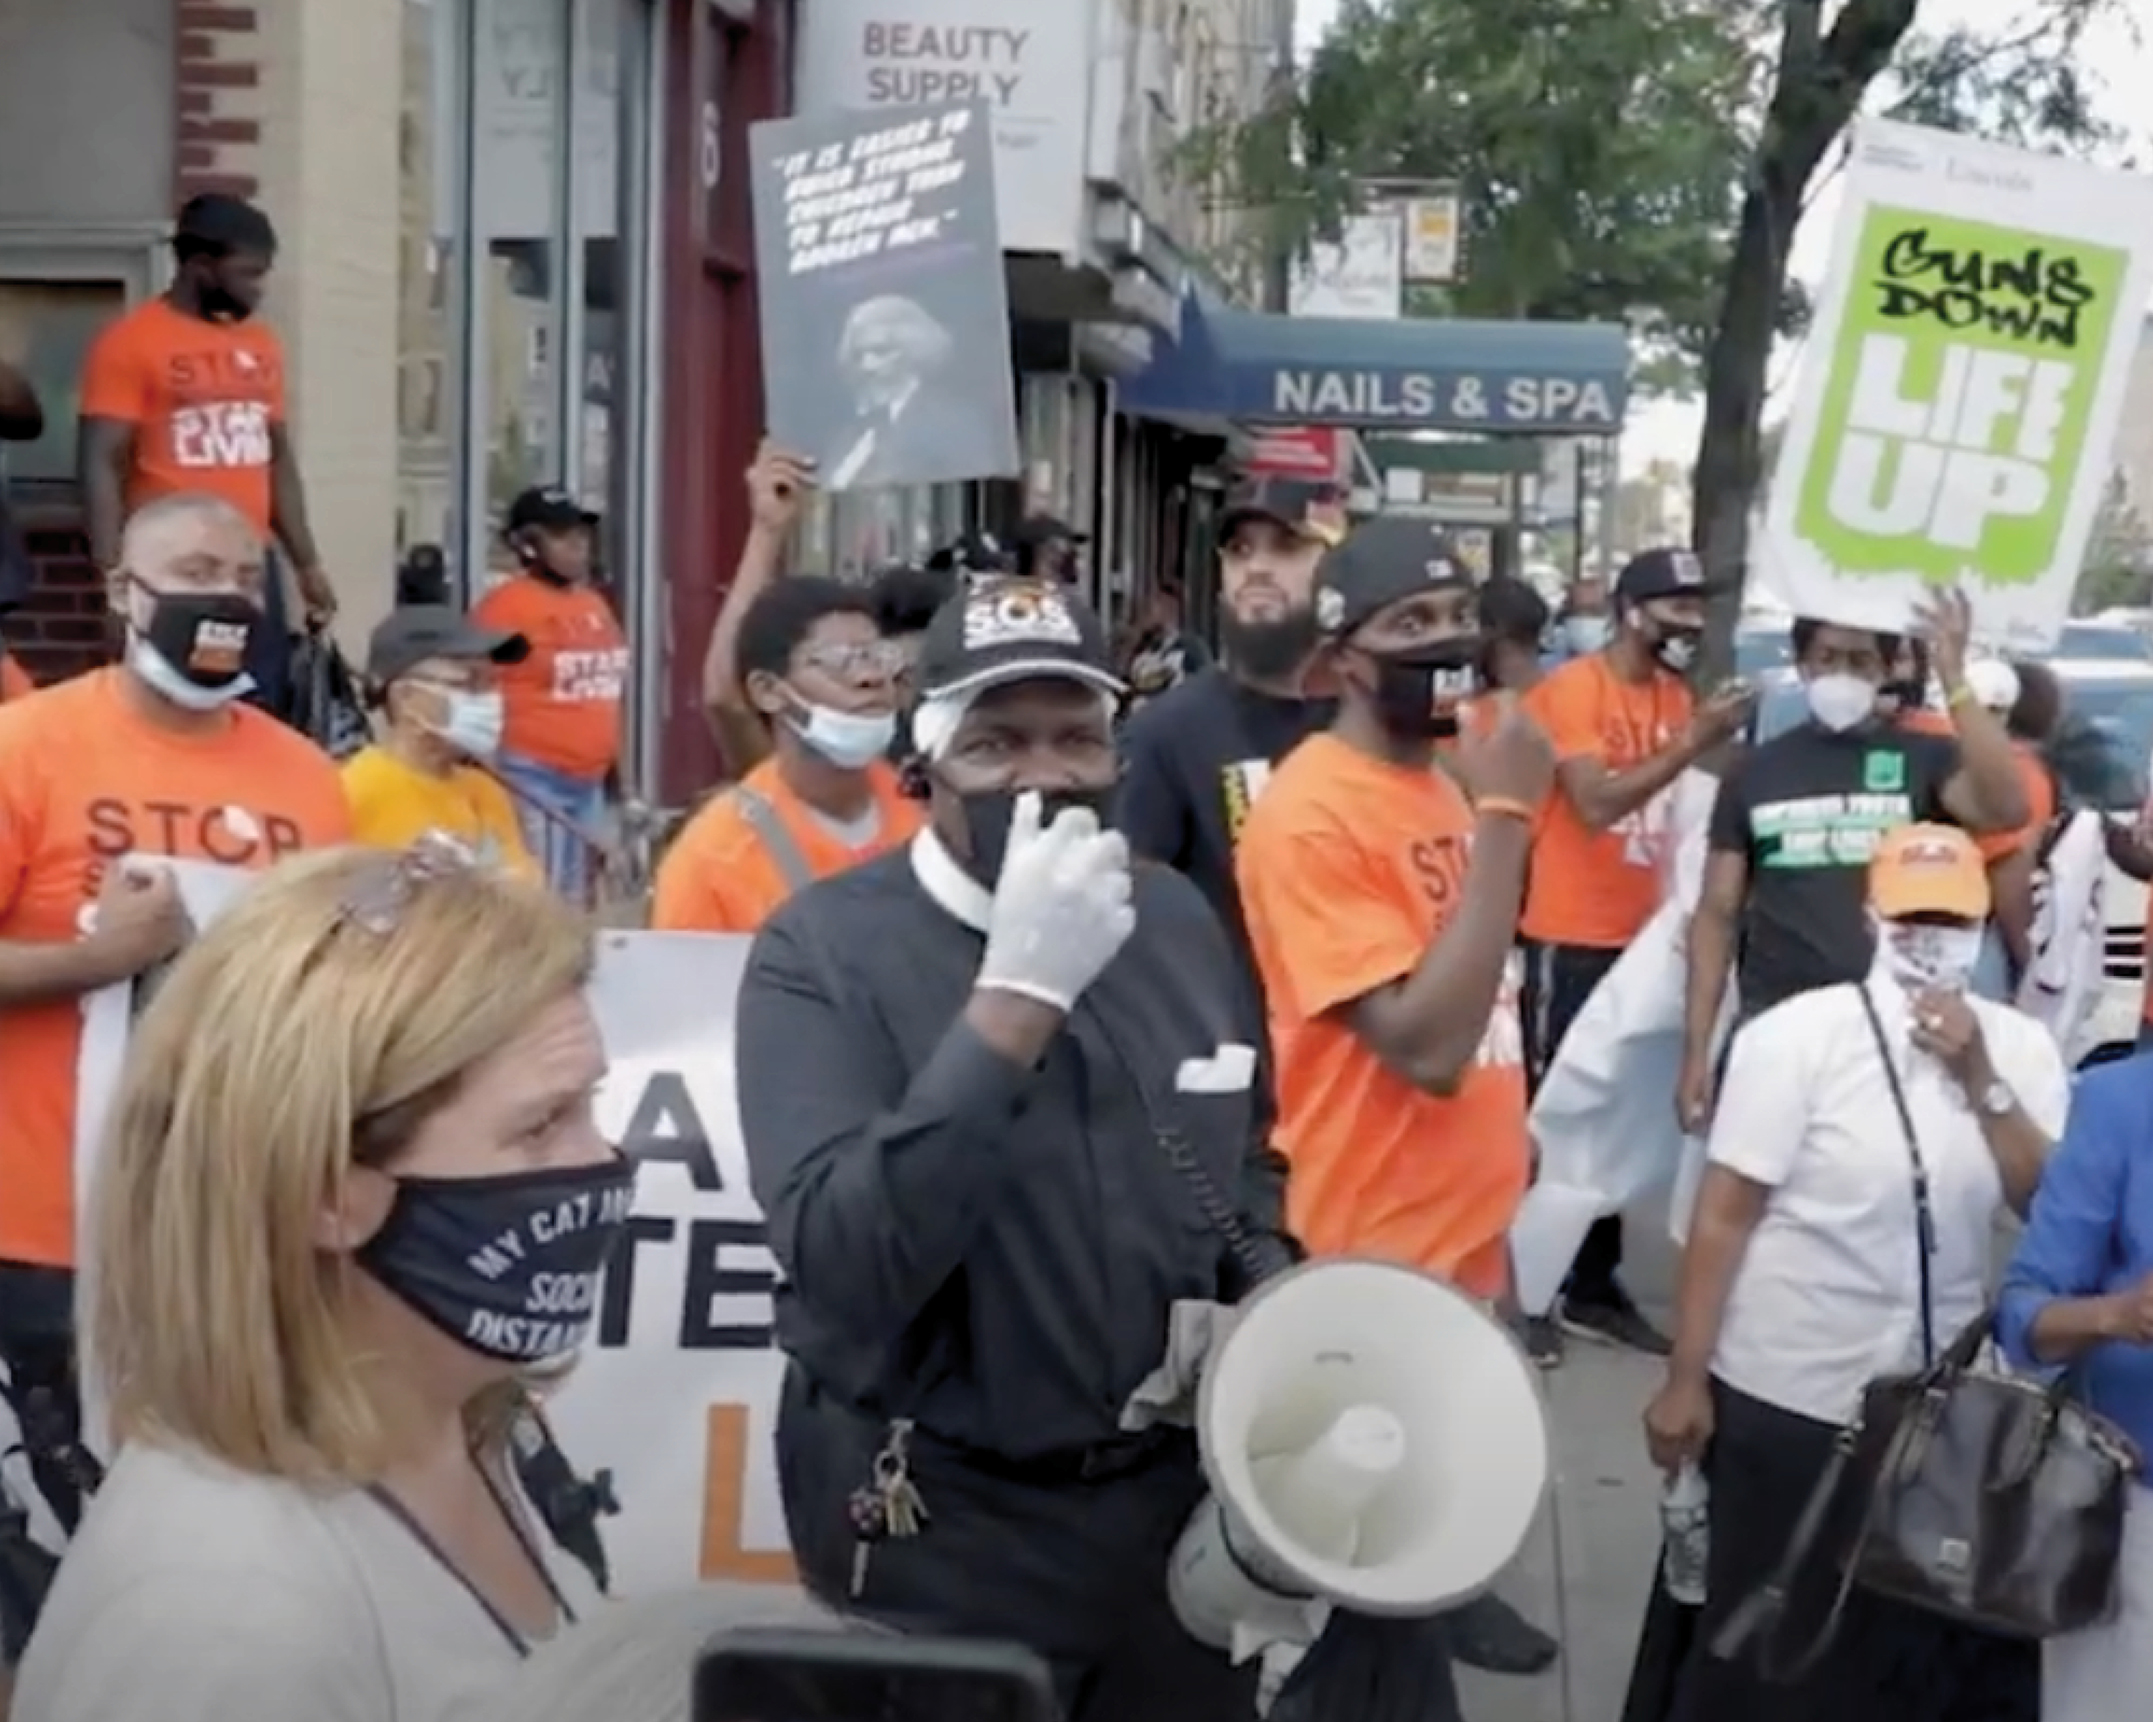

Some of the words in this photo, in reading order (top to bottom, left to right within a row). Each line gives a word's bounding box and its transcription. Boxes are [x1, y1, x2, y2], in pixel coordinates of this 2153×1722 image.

[862, 20, 1029, 63] BEAUTY
[867, 67, 1020, 107] SUPPLY
[1883, 229, 2095, 307] GUNS
[1872, 280, 2078, 348] DOWN
[1274, 371, 1434, 415] NAILS
[1451, 374, 1488, 418] &
[1504, 376, 1613, 422] SPA
[1847, 332, 2078, 462] LIFE
[1827, 430, 2051, 549] UP
[86, 797, 303, 868] STOP
[466, 1228, 526, 1281] MY
[529, 1192, 592, 1244] CAT
